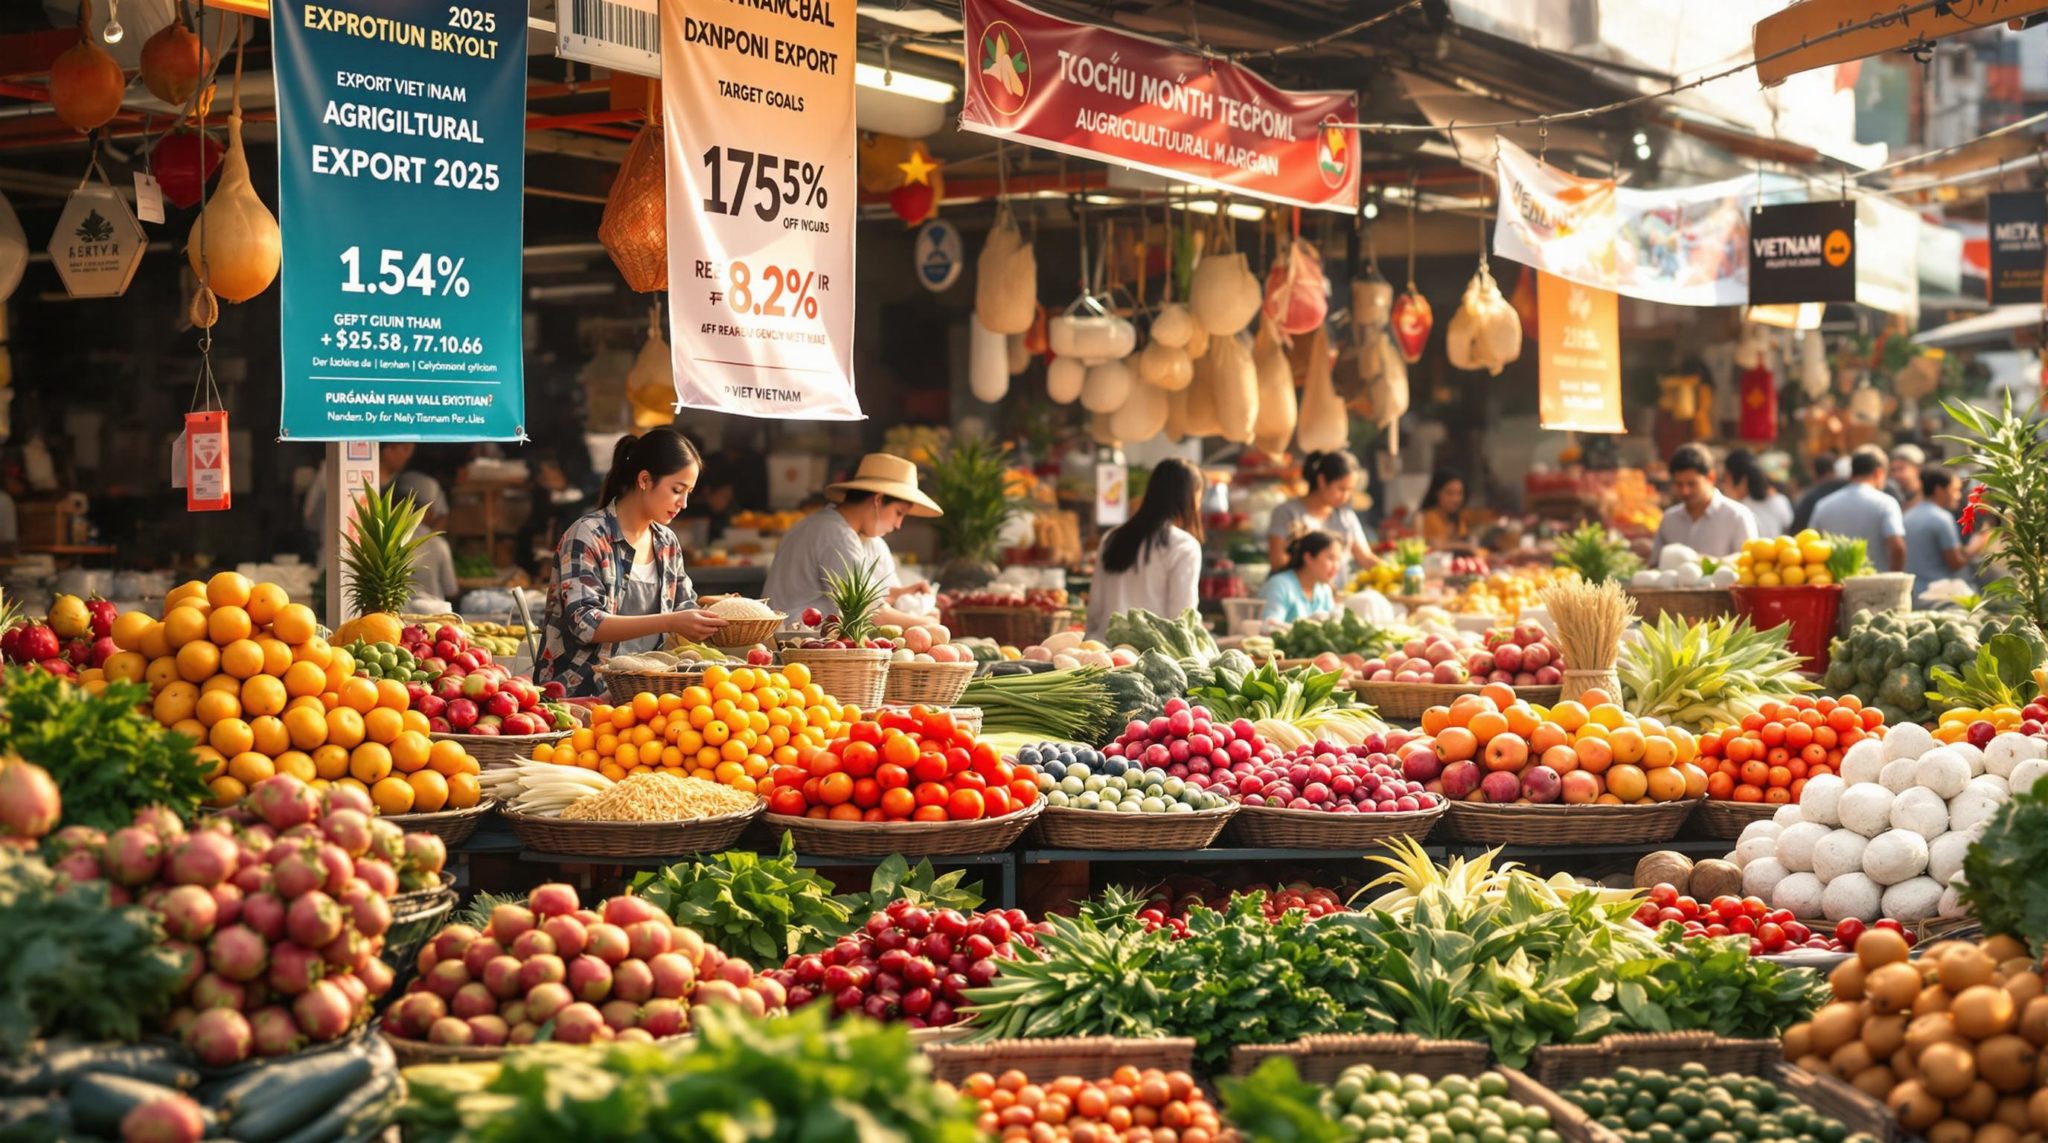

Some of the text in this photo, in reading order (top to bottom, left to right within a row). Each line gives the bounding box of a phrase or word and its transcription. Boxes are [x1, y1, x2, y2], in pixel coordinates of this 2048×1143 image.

[304, 4, 498, 60] EXPROTIUN BKYOLT
[448, 6, 496, 33] 2025
[775, 39, 838, 75] EXPORT
[336, 71, 392, 92] EXPORT
[394, 78, 424, 97] VIET
[718, 79, 804, 112] TARGET GOALS
[312, 144, 500, 192] EXPORT 2025
[783, 217, 799, 230] OFF
[1753, 235, 1821, 258] VIETNAM
[340, 246, 470, 298] 1.54%
[728, 261, 818, 319] 8.2%
[407, 317, 442, 330] THAM
[732, 386, 753, 399] VIET
[755, 387, 801, 402] VIETNAM
